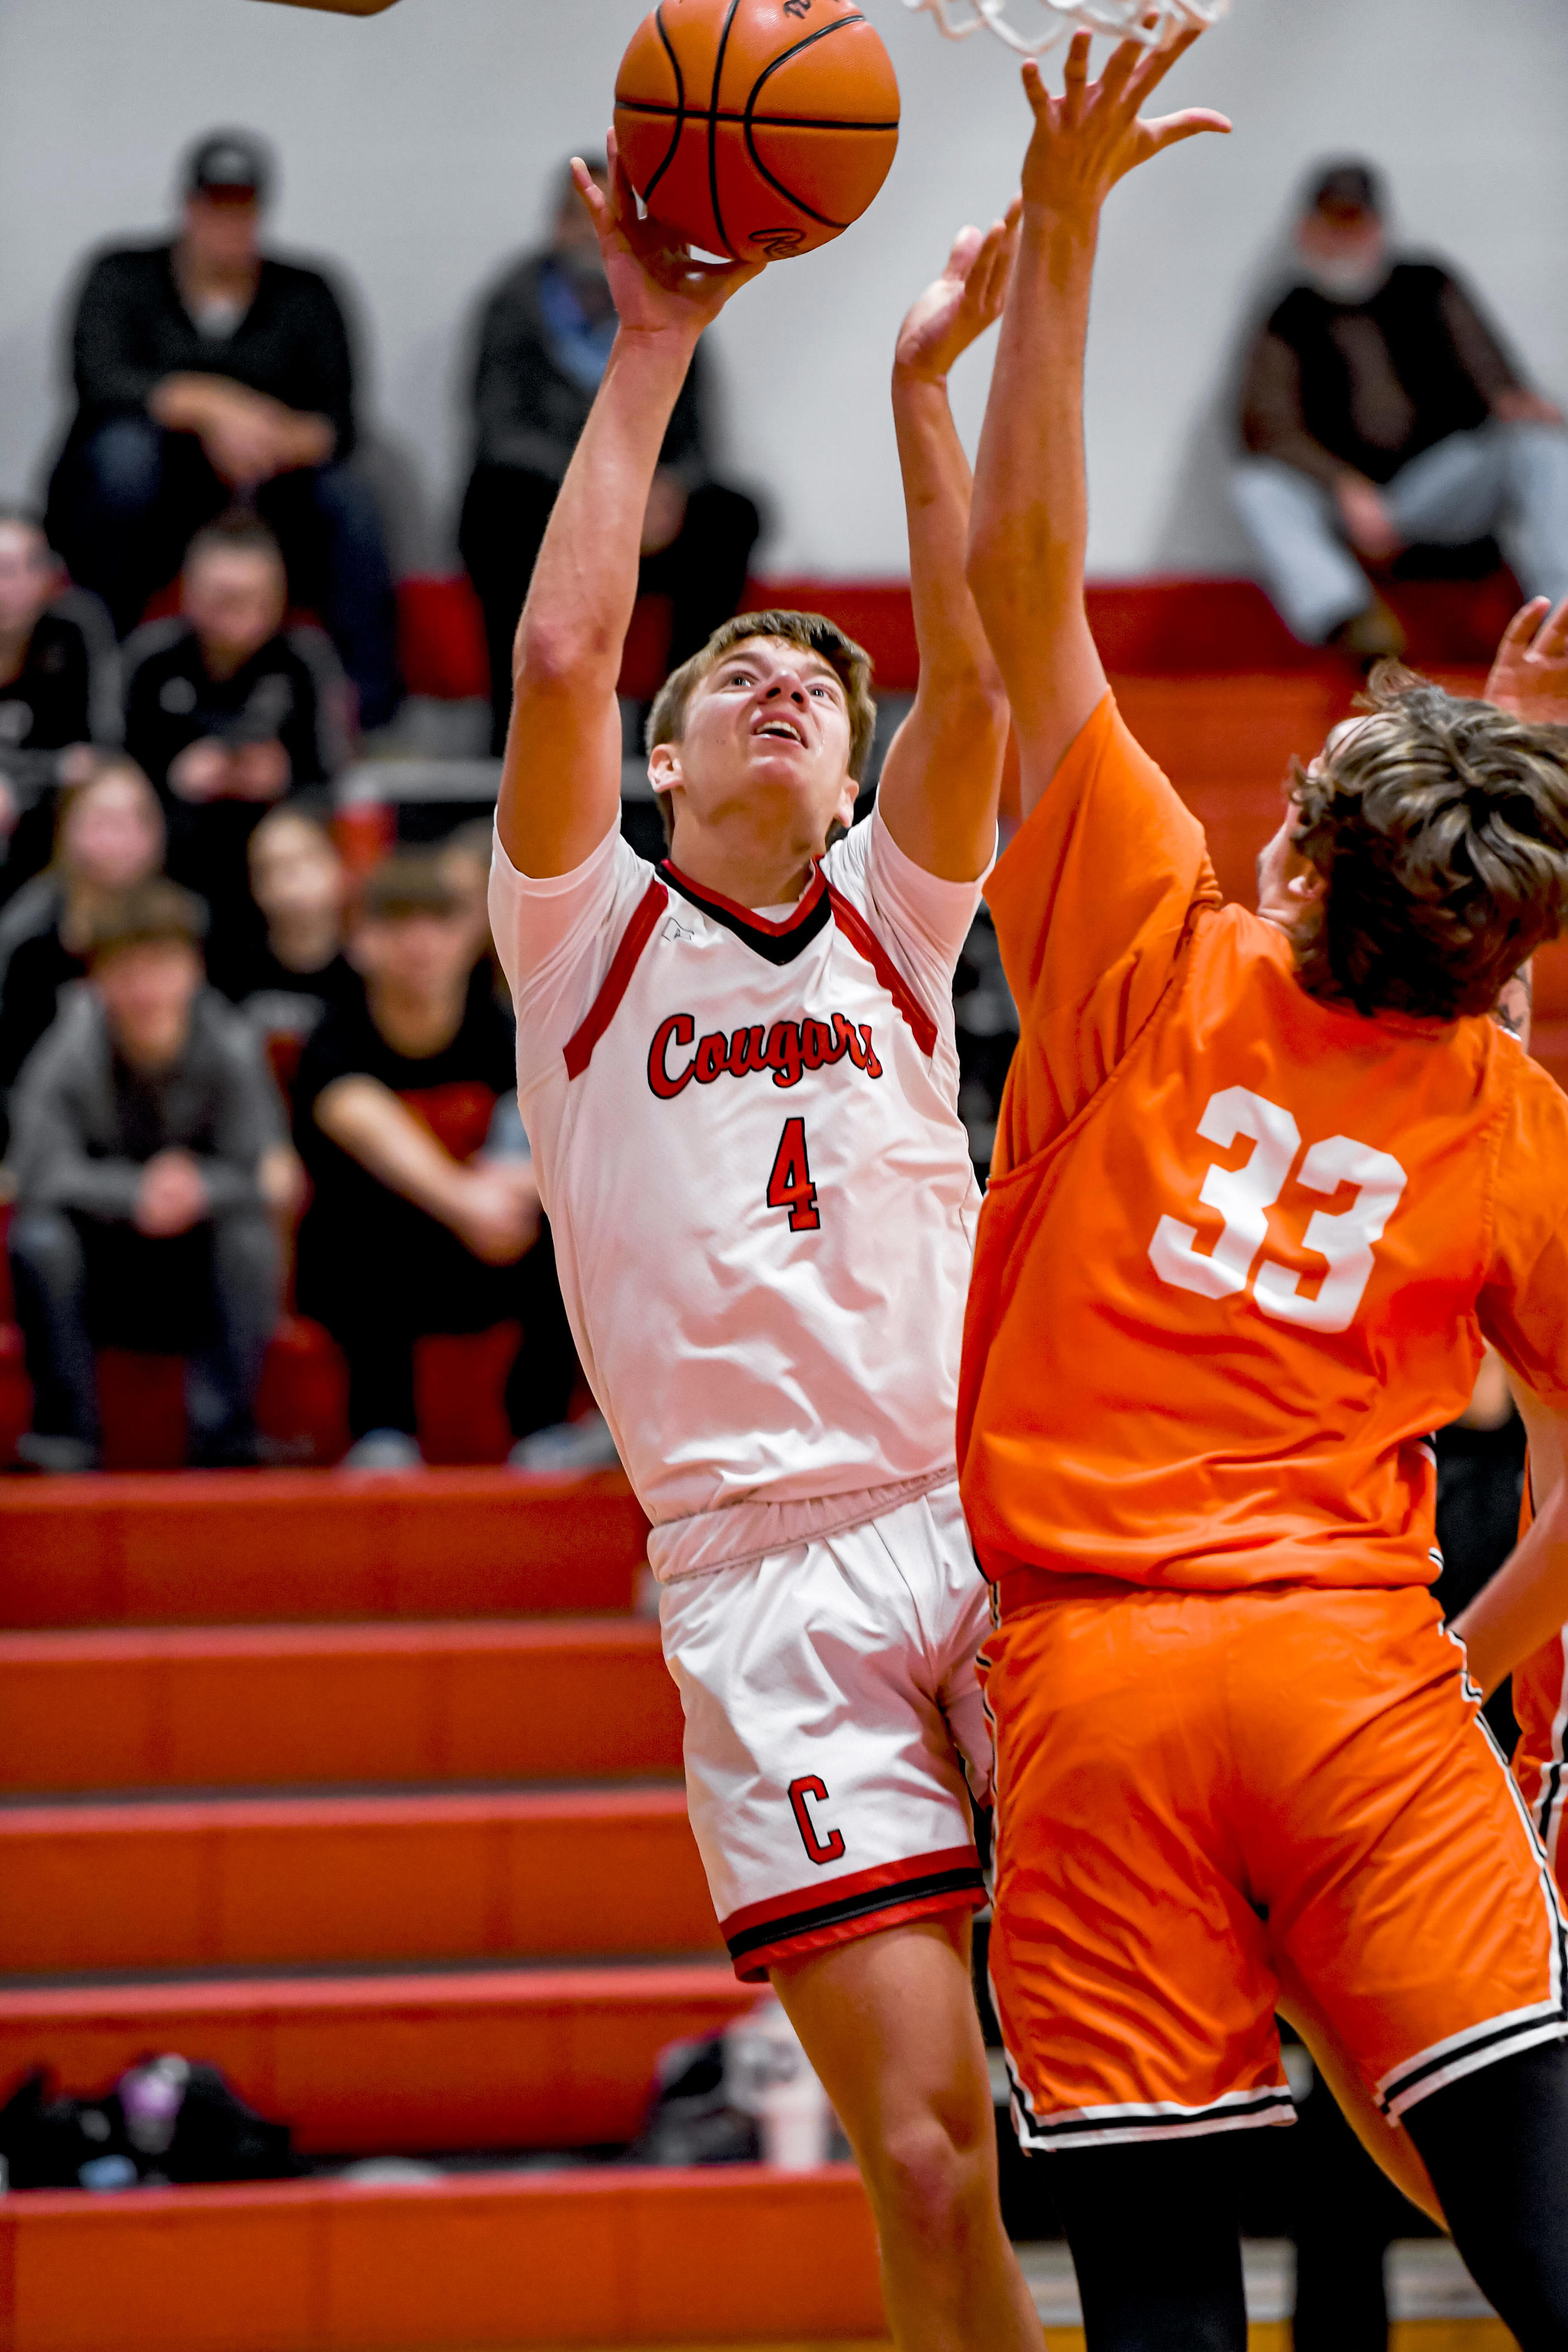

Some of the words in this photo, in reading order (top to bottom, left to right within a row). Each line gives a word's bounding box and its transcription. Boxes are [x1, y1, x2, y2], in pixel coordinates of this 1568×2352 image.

[766, 1116, 821, 1232] 4
[1148, 1085, 1408, 1334] 33
[788, 1774, 846, 1865] C
